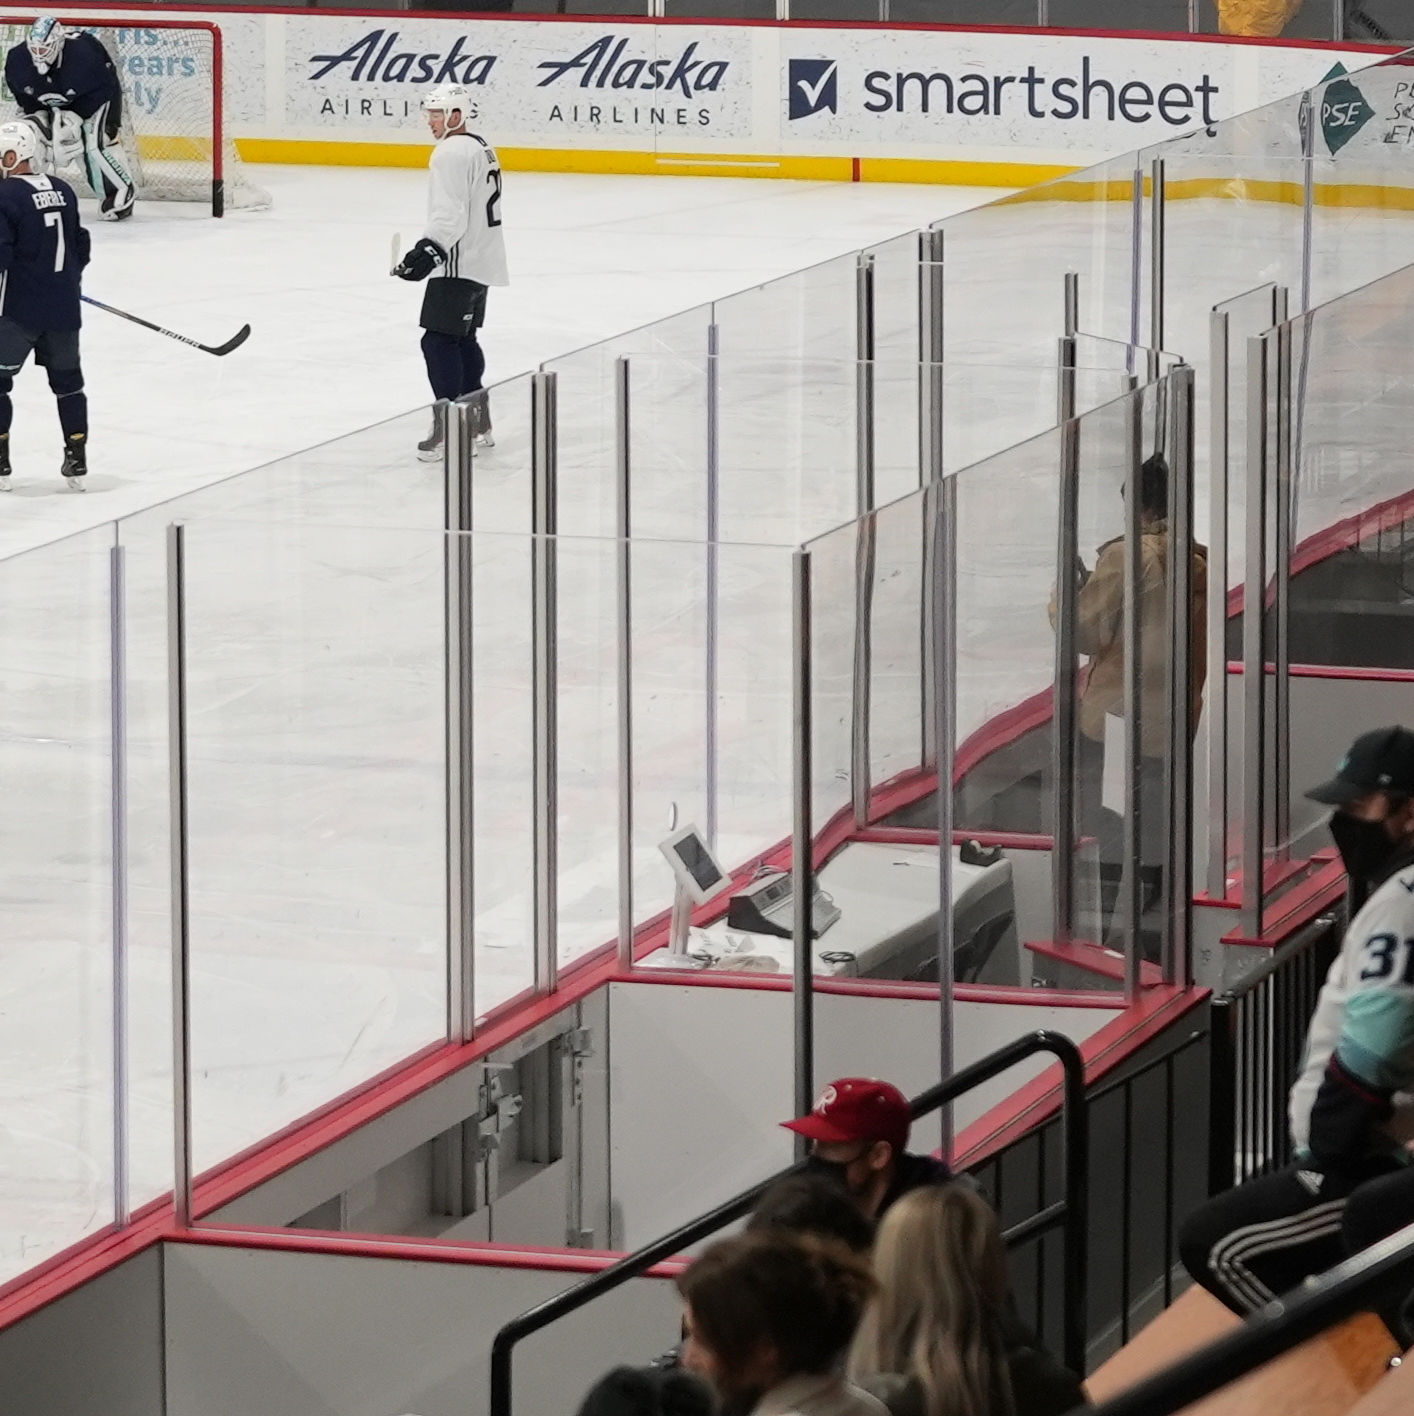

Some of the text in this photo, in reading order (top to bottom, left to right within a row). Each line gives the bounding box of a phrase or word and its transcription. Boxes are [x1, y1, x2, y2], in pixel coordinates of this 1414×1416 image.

[308, 29, 497, 85] Alaska
[536, 34, 730, 99] Alaska
[321, 98, 479, 120] AIRLIS
[549, 104, 711, 126] AIRLINES
[863, 55, 1220, 137] smartsheet
[44, 211, 66, 273] 7
